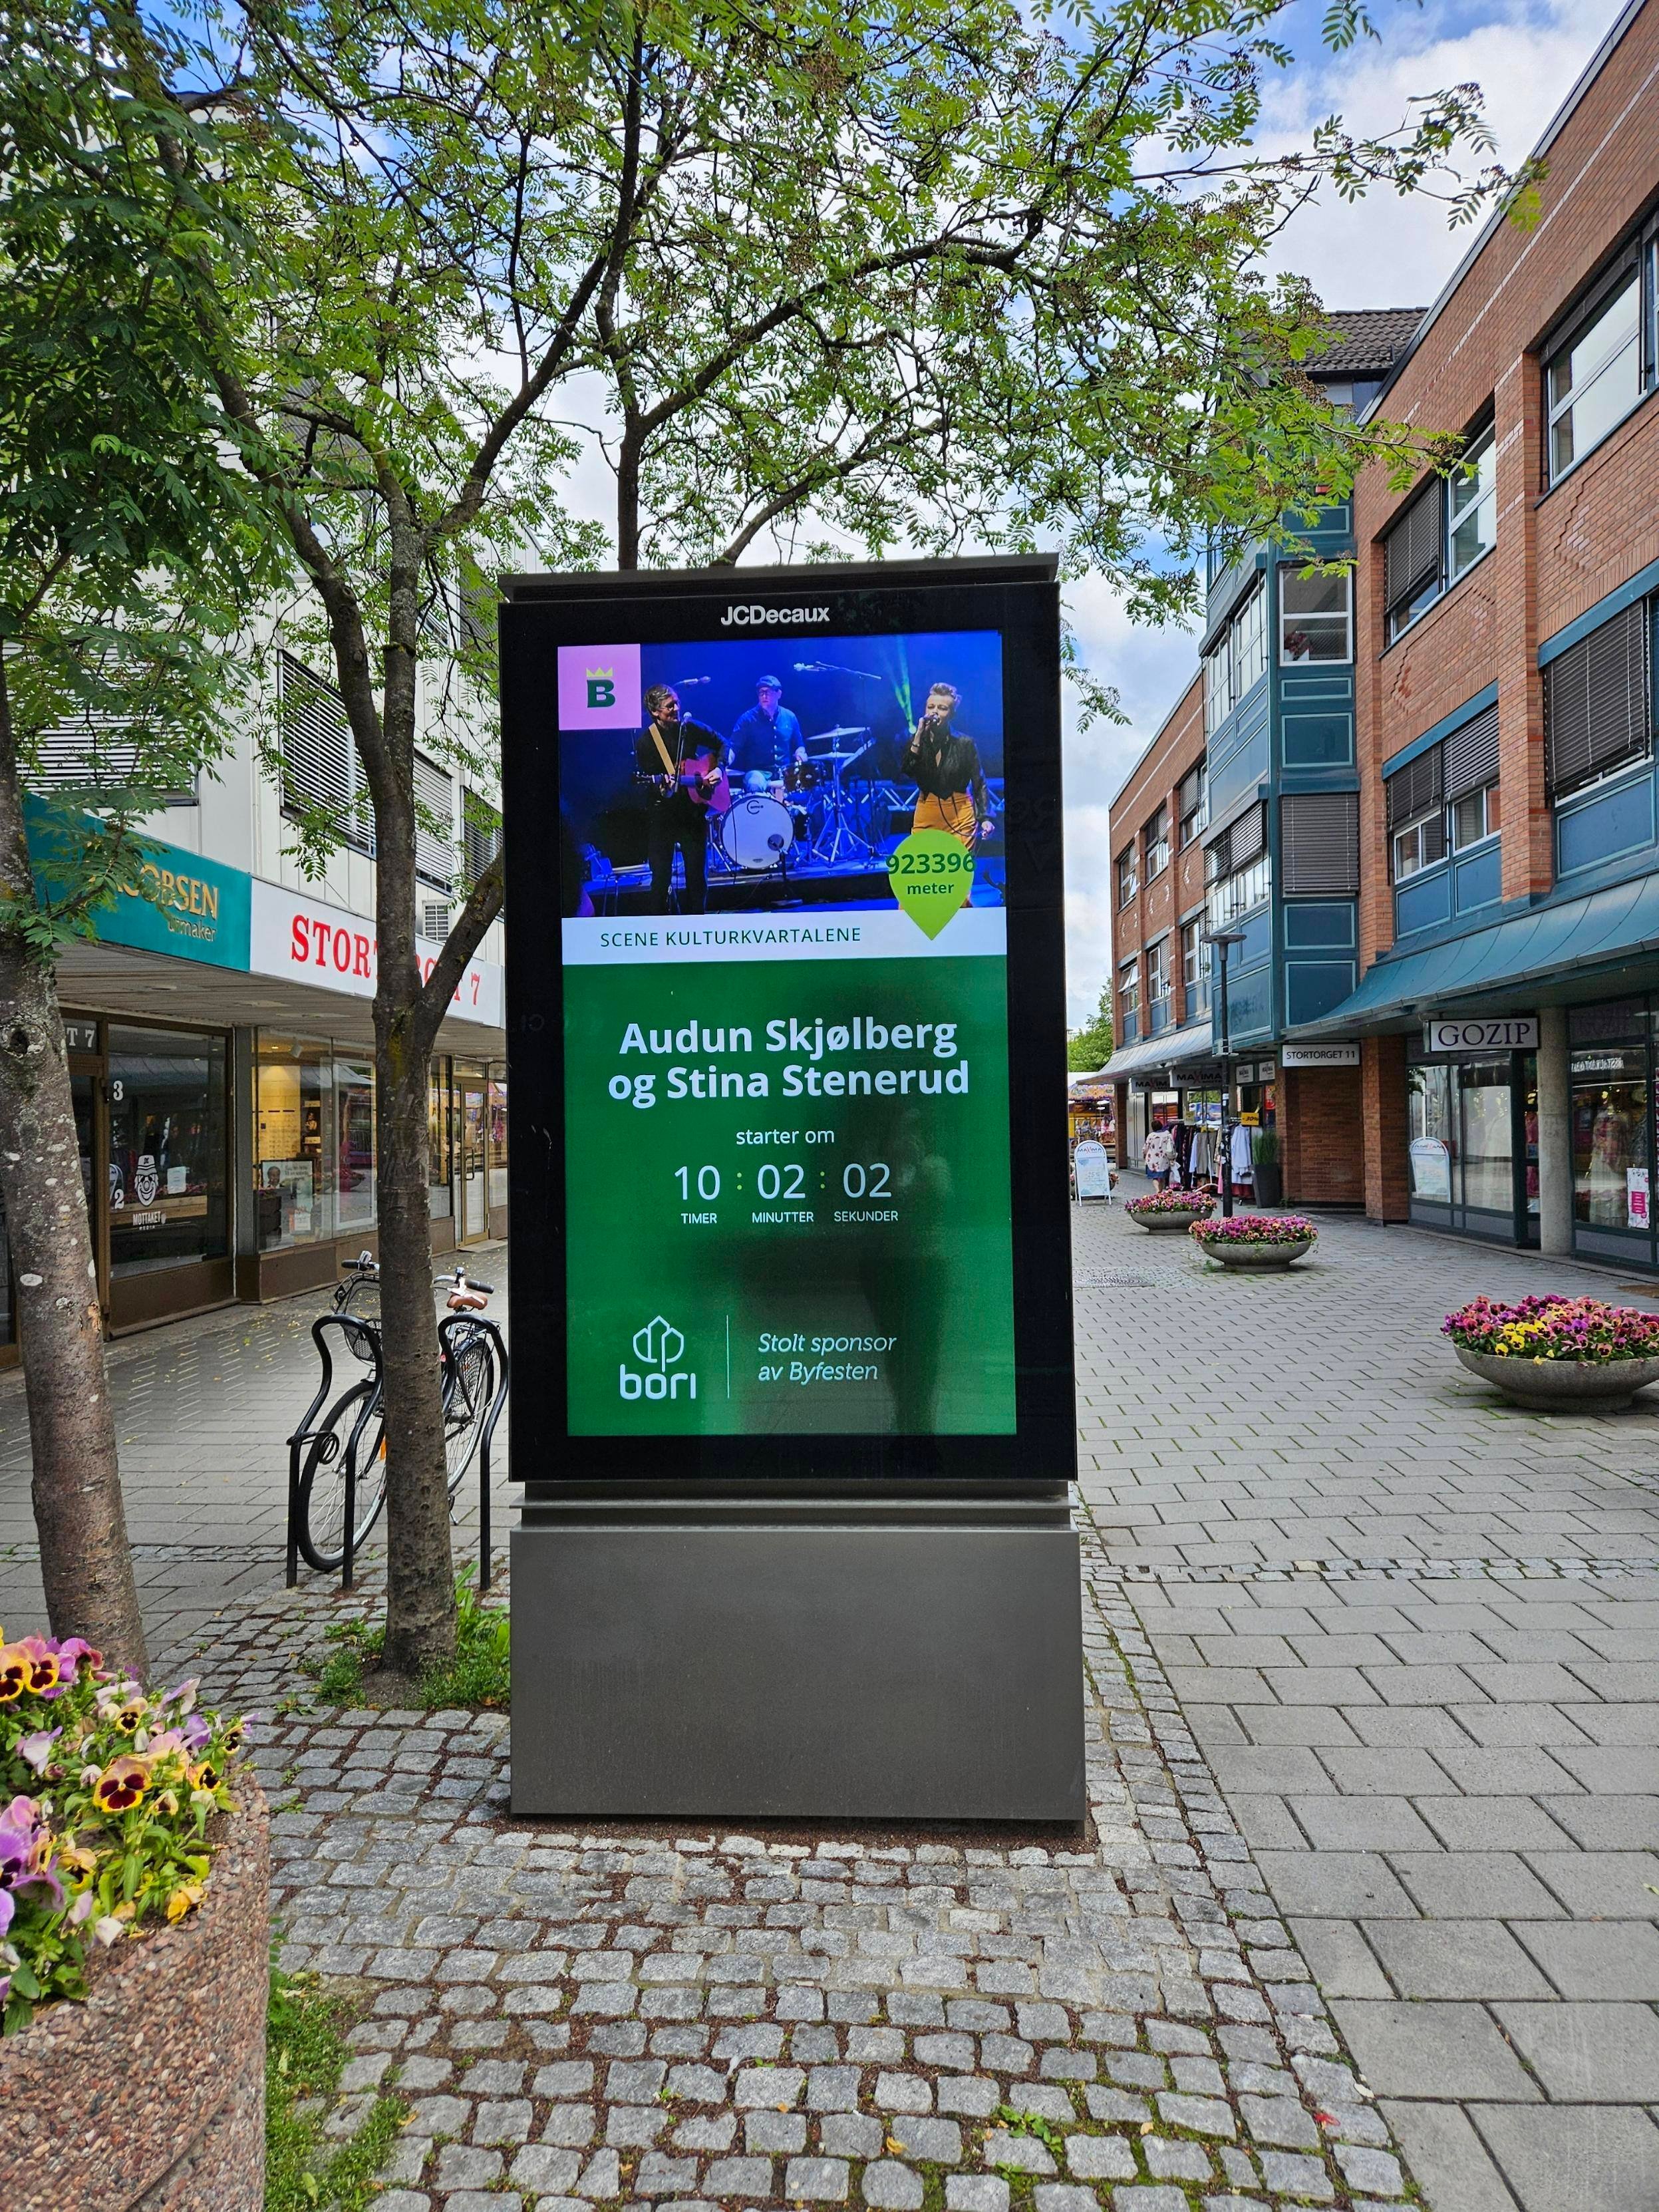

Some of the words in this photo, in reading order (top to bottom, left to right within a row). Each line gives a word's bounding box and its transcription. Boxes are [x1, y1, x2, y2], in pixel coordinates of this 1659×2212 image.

[720, 605, 830, 625] JCDecaux
[586, 679, 616, 709] B
[886, 852, 976, 875] 923396
[907, 883, 955, 895] meter
[601, 932, 659, 947] SCENE
[666, 927, 861, 946] KULTURKVARTALENE
[471, 972, 480, 1005] 7
[85, 1029, 94, 1047] 7
[619, 1020, 752, 1054] Audun
[765, 1017, 957, 1060] Skjølberg
[1437, 1023, 1531, 1046] GOZIP
[1286, 1050, 1343, 1060] STORTORGET
[608, 1074, 656, 1109] og
[667, 1064, 769, 1099] Stina
[782, 1060, 969, 1097] Stenerud
[1135, 1078, 1171, 1090] MAXIM
[1176, 1071, 1222, 1085] MAXIMA
[113, 1080, 123, 1101] 3
[736, 1129, 800, 1145] starter
[805, 1130, 834, 1144] om
[675, 1165, 720, 1200] 10
[757, 1164, 806, 1199] 02
[843, 1162, 892, 1198] 02
[114, 1189, 124, 1209] 2
[680, 1212, 717, 1224] TIMER
[752, 1211, 814, 1223] MINUTTER
[834, 1210, 899, 1222] SEKUNDER
[758, 1333, 806, 1352] Stolt
[810, 1337, 897, 1356] sponsor
[619, 1363, 697, 1400] bori
[758, 1366, 784, 1381] av
[789, 1361, 878, 1386] Byfesten
